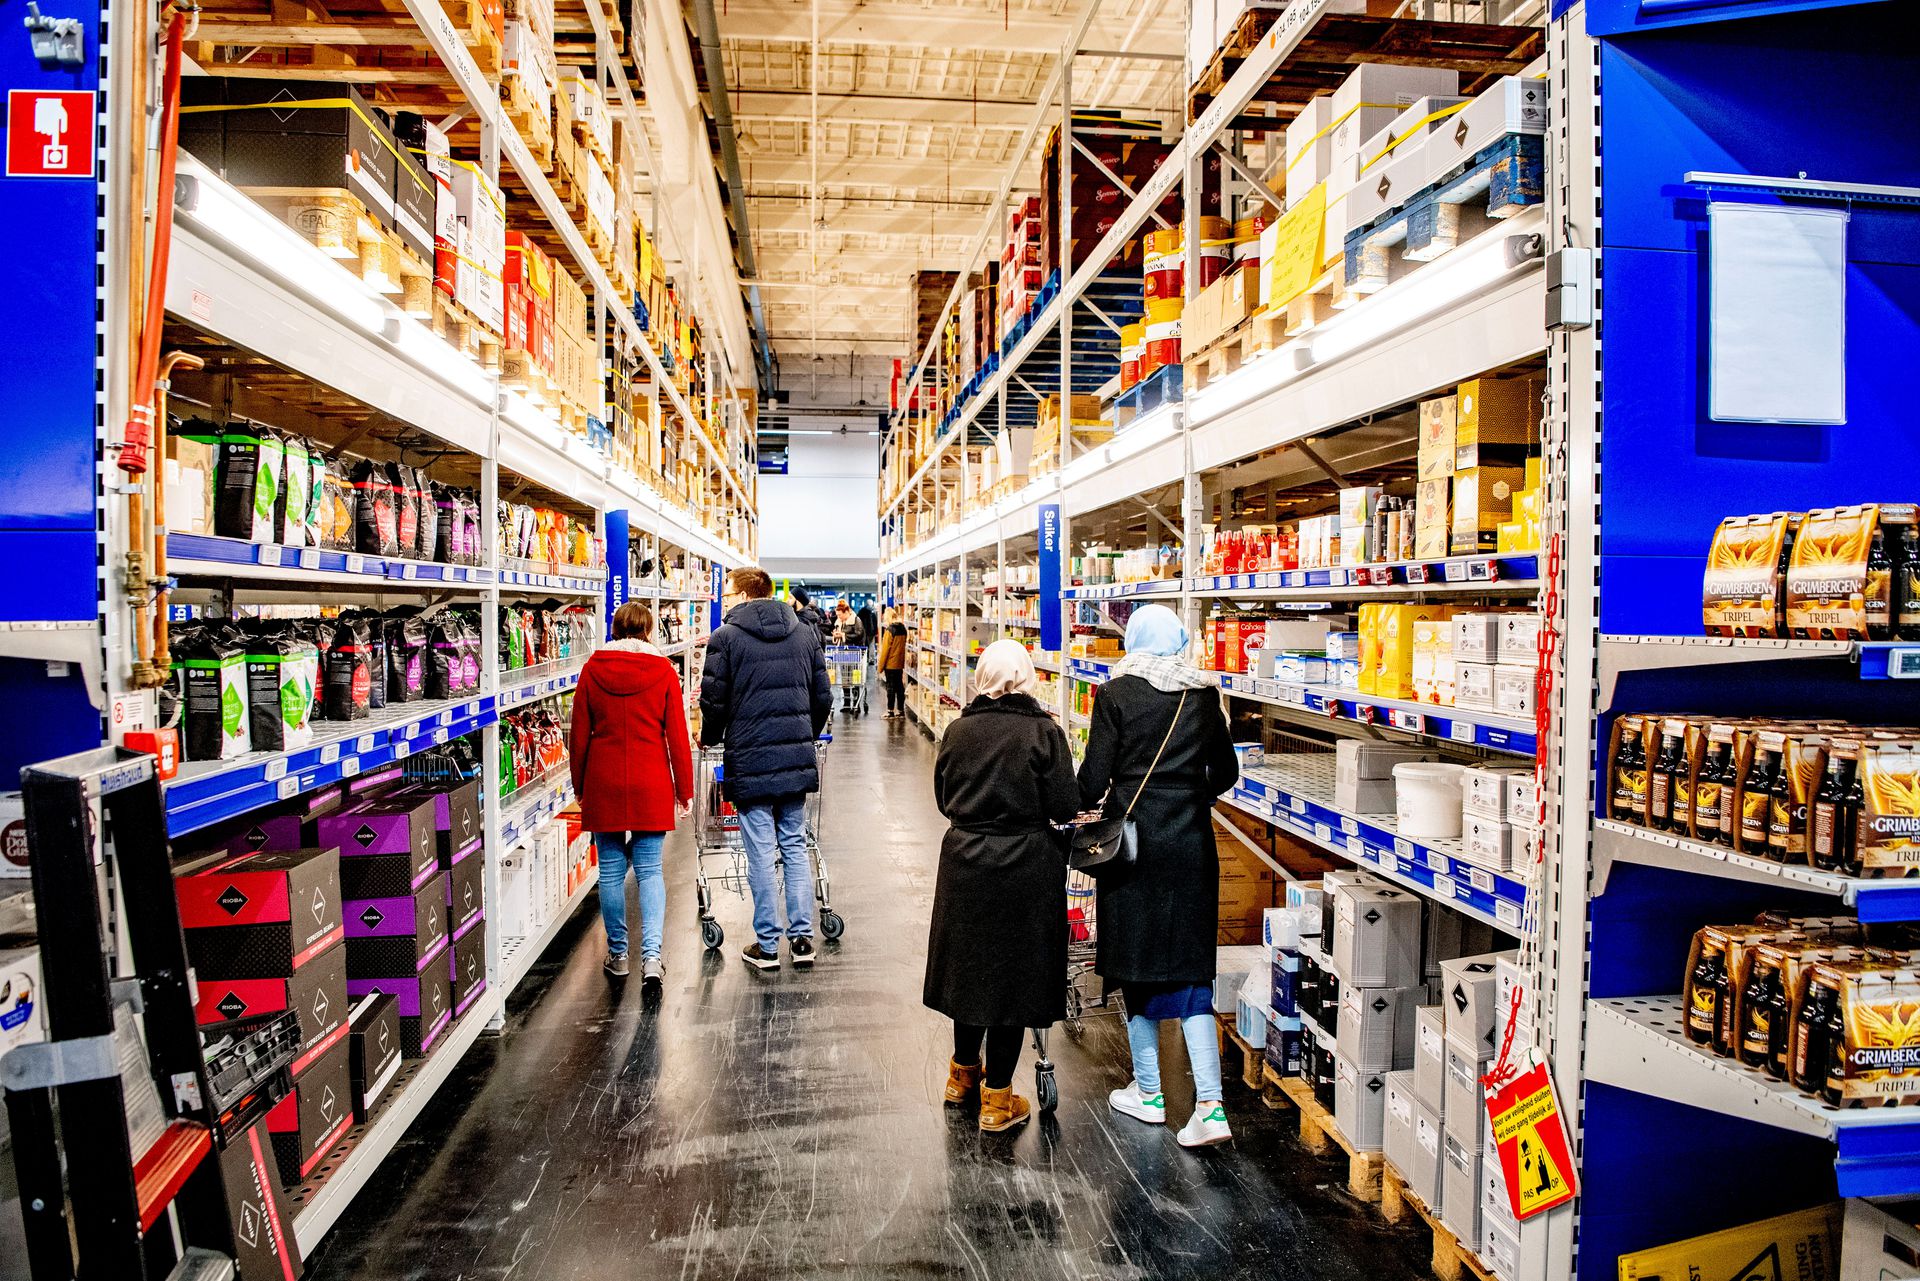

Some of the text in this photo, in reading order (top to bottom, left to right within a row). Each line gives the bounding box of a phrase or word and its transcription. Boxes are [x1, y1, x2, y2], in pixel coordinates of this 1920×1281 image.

[1096, 189, 1120, 201] Senseo
[302, 215, 336, 228] EPAL
[1044, 510, 1055, 552] Suiker
[1709, 582, 1769, 595] GRIMBERGEN
[1792, 580, 1859, 595] GRIMBERGEN
[1723, 611, 1754, 623] TRIPEL
[1808, 612, 1843, 624] TRIPEL
[306, 1019, 339, 1050] ESPRESSO BEANS
[1875, 1081, 1918, 1093] TRIPEL
[1493, 1089, 1550, 1128] Voor uw veiligheid sluiten
[1505, 1125, 1516, 1137] deze
[1517, 1118, 1528, 1130] gang
[1529, 1107, 1546, 1124] tijdelijk
[314, 1126, 333, 1149] ESPRESSO
[259, 1163, 269, 1187] DARK
[1523, 1177, 1559, 1200] PAS OP
[250, 1161, 278, 1256] ESPRESSO BEANS
[244, 1208, 255, 1239] RIOBA
[272, 1217, 282, 1242] SLOW
